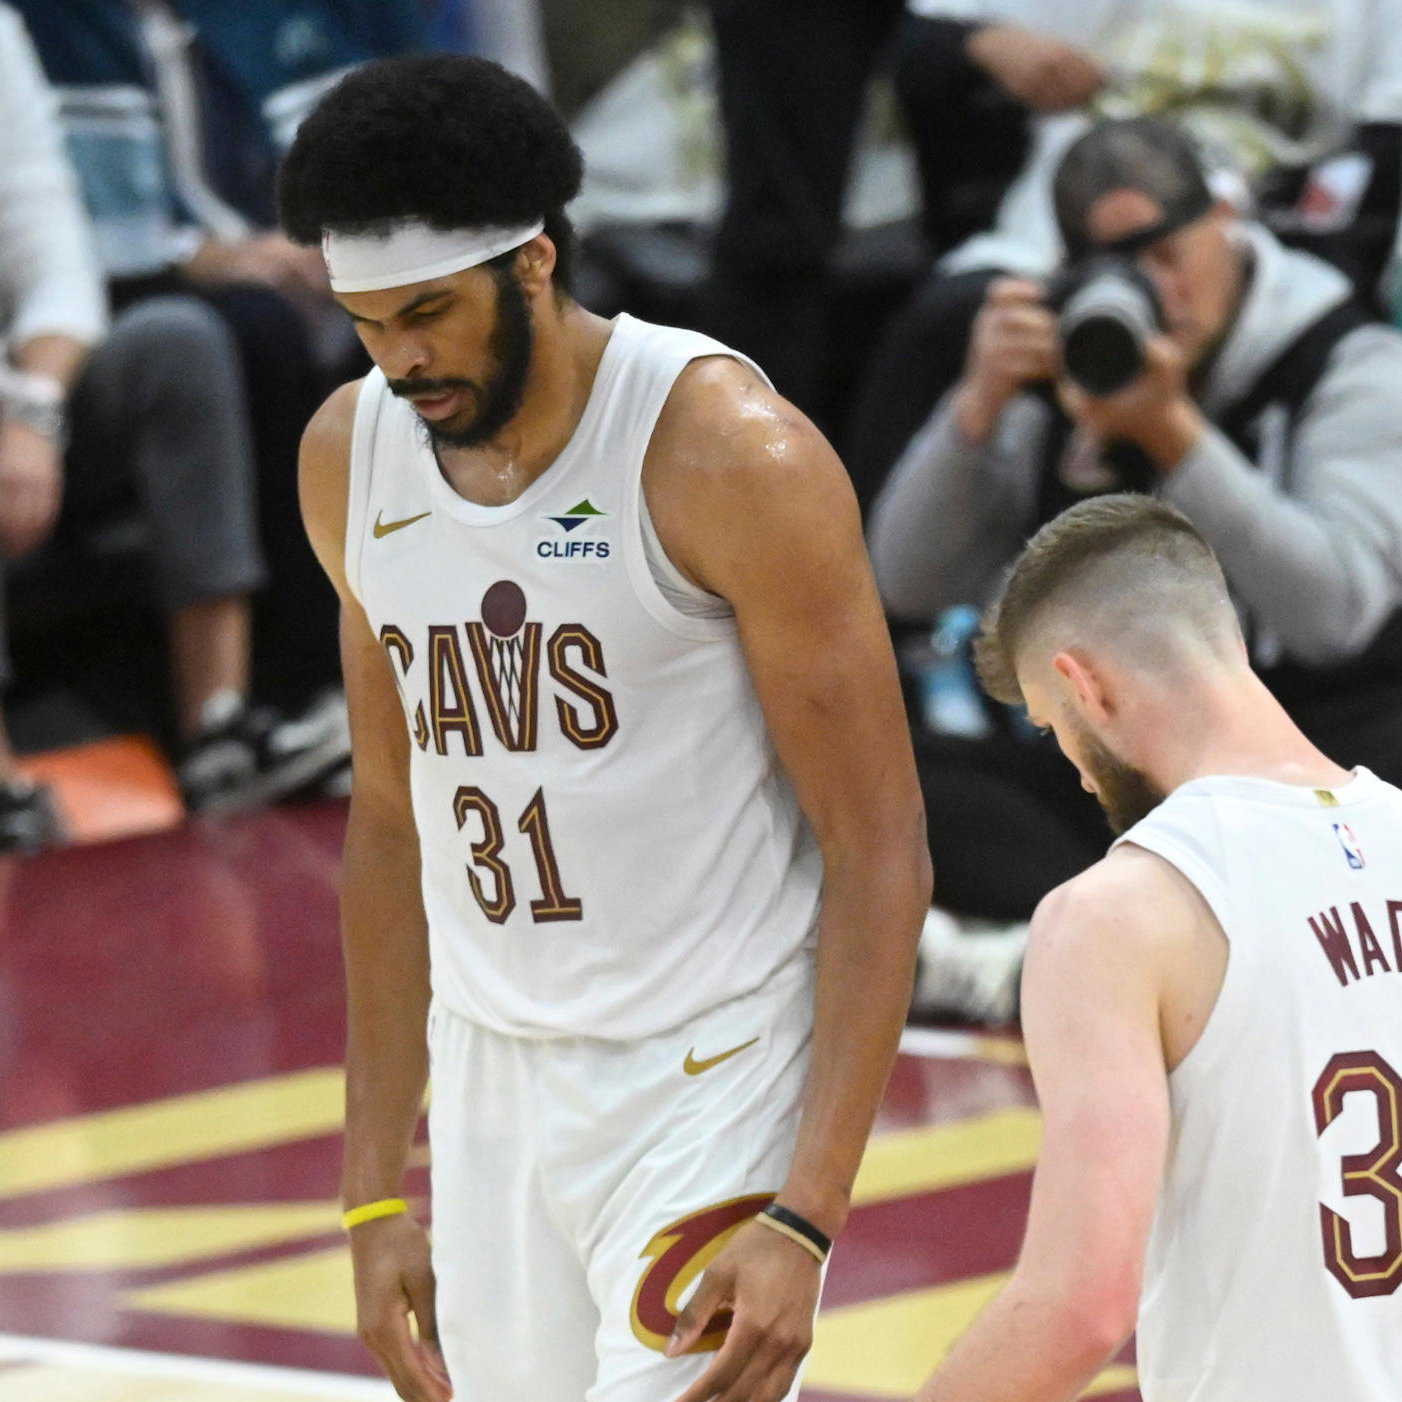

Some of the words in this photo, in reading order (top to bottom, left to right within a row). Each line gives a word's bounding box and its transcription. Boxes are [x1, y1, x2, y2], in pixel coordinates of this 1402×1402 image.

[537, 540, 610, 560] CLIFFS
[380, 621, 619, 757] CAVS
[453, 785, 584, 924] 31
